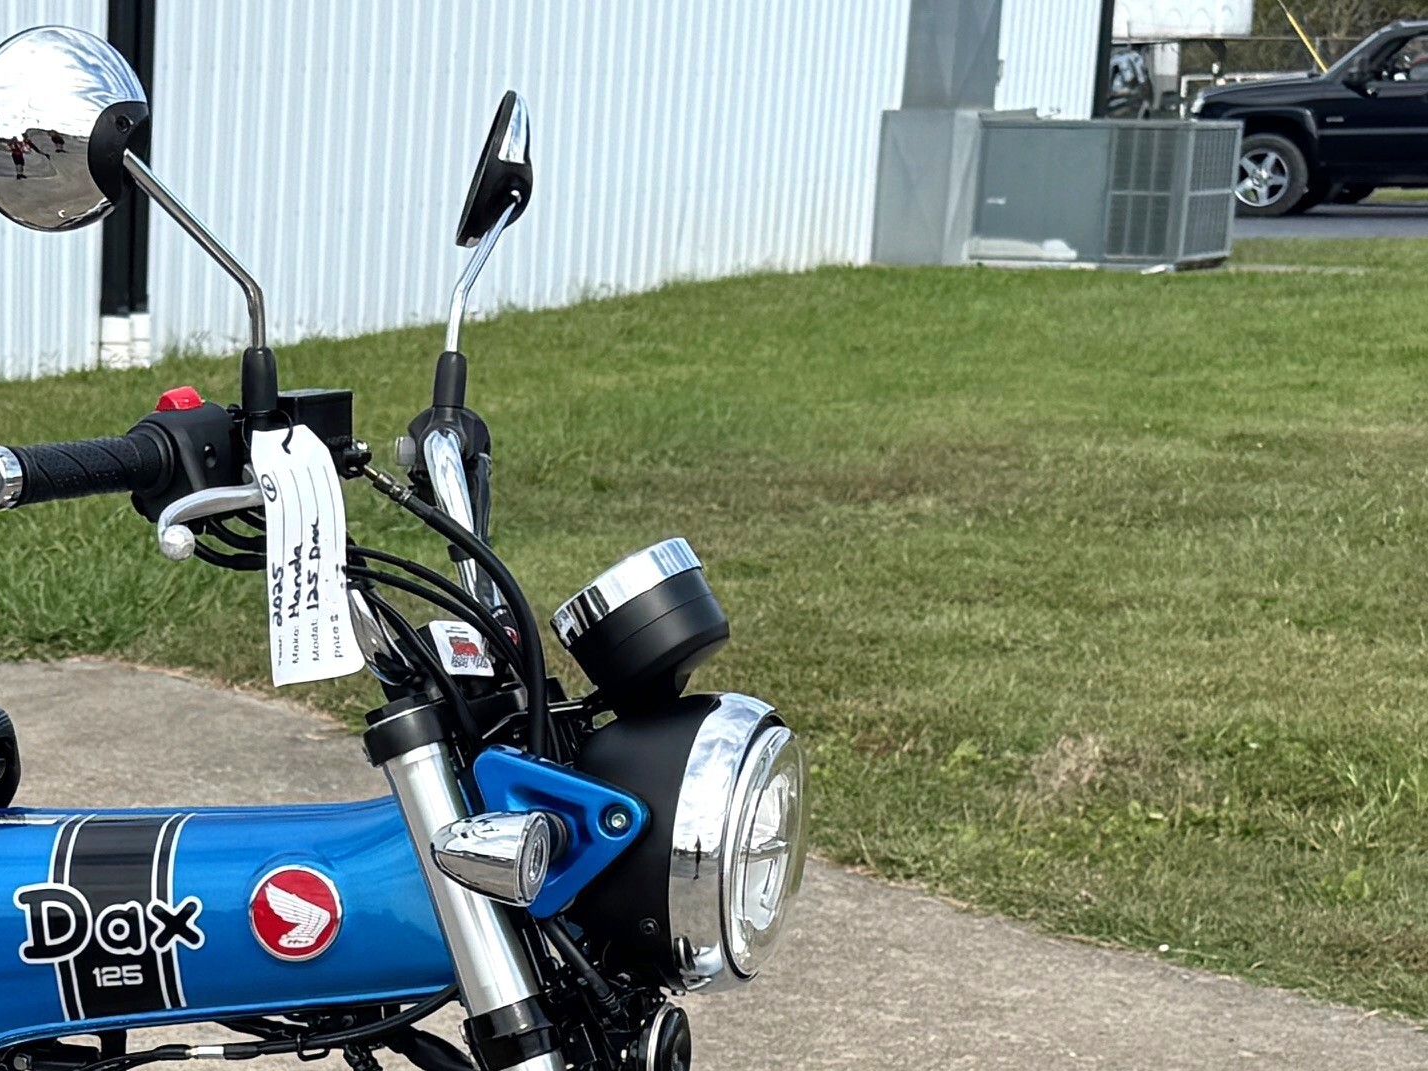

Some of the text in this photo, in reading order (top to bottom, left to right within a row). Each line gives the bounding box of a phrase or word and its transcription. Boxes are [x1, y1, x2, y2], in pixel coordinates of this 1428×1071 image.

[272, 561, 283, 627] 2025
[288, 541, 302, 618] Honda
[306, 570, 319, 609] 125
[13, 882, 206, 964] Dax
[92, 964, 144, 987] 125
